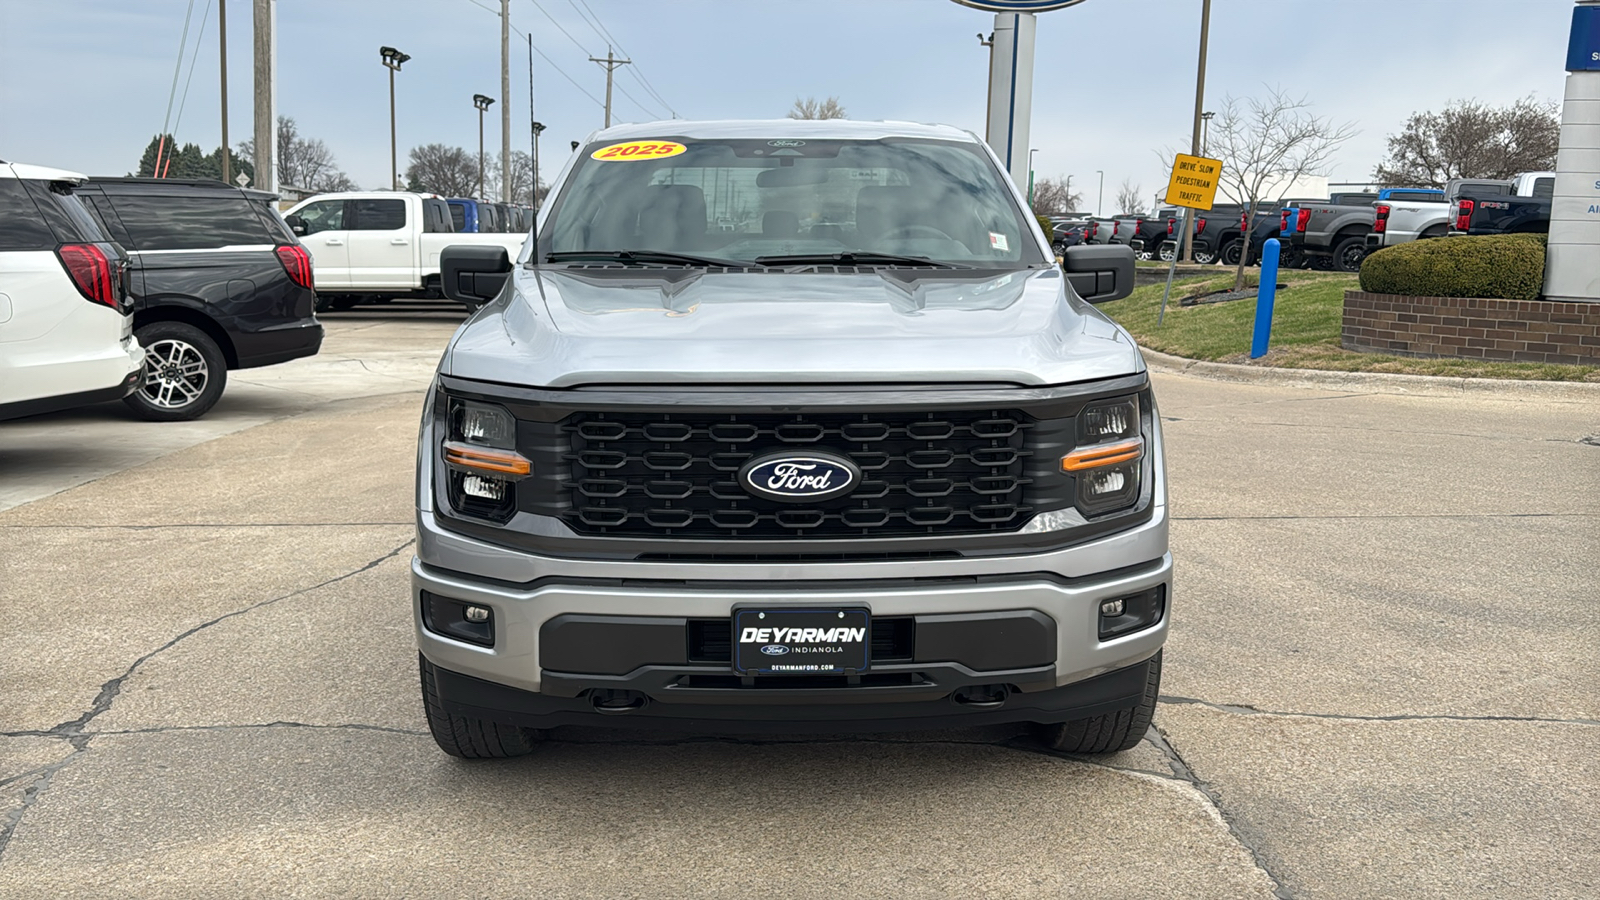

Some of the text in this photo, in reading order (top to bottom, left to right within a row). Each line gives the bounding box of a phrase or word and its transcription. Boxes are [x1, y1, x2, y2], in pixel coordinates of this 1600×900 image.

[600, 144, 678, 158] 2025
[1179, 161, 1214, 174] DRIVE SLOW
[1175, 175, 1211, 188] PEDESTRIAN
[1179, 191, 1202, 202] TRAFFIC
[767, 463, 833, 489] Ford
[739, 627, 866, 643] DEYARMAN
